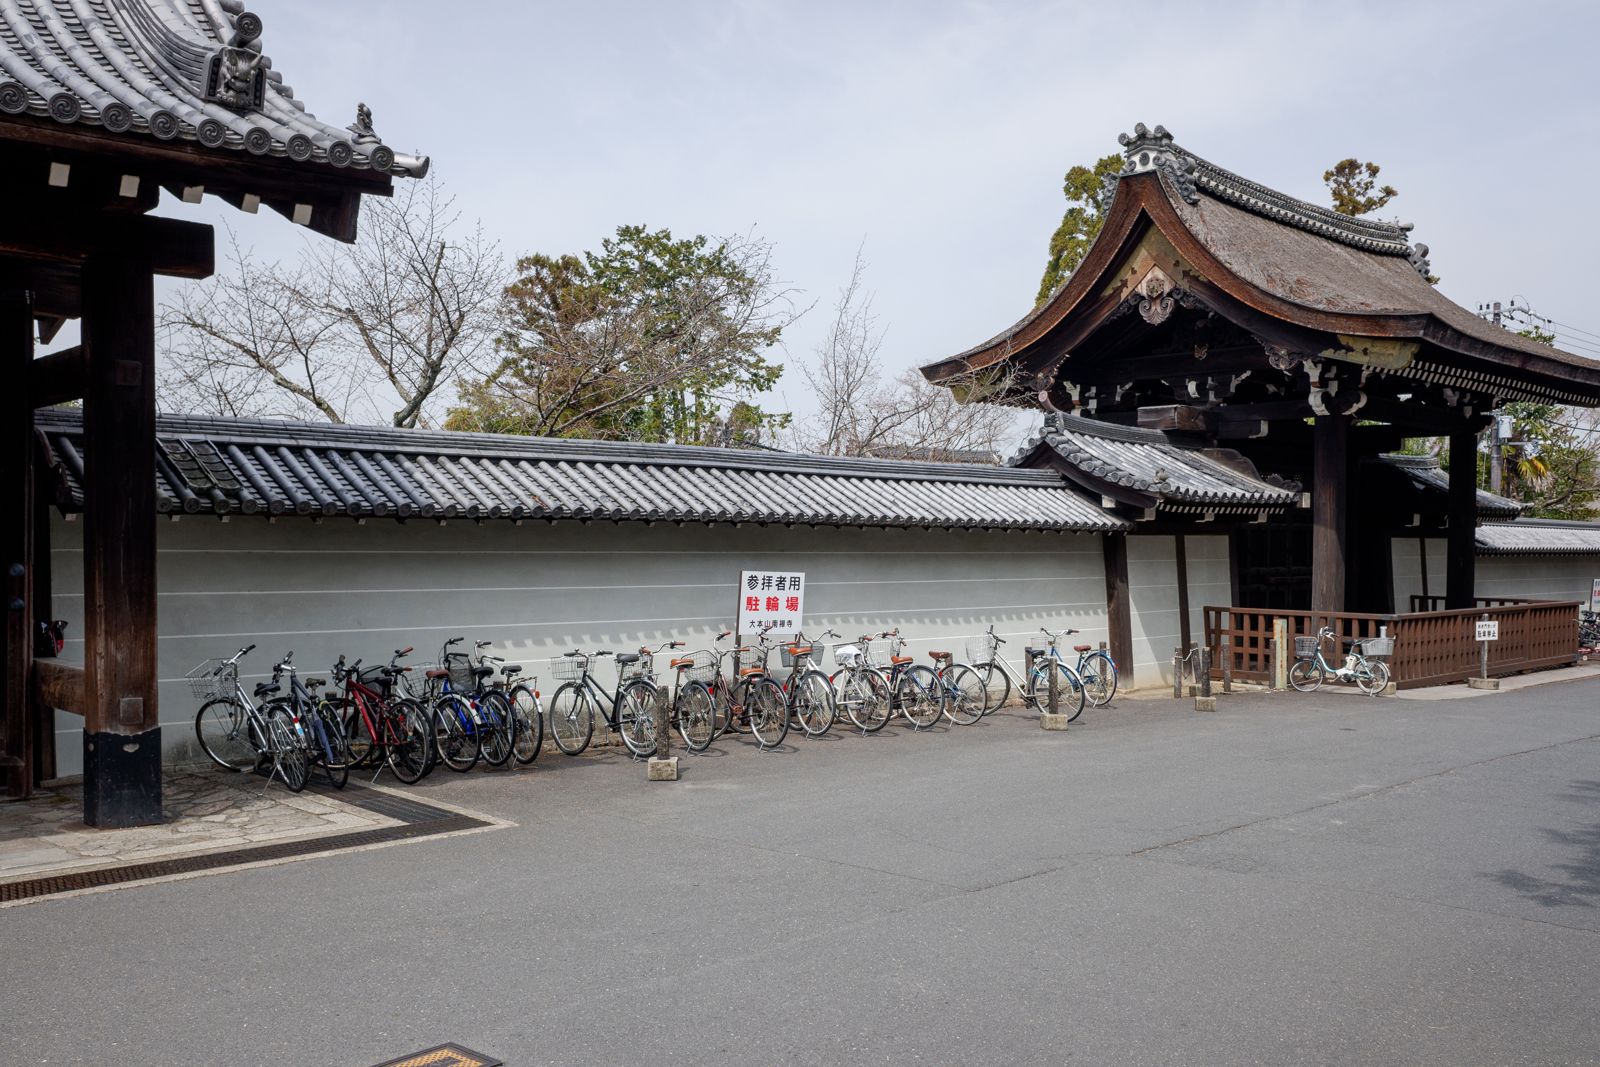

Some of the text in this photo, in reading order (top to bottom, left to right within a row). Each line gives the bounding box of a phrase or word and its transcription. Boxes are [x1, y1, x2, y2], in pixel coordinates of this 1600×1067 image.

[747, 574, 801, 591] 参拝者用
[745, 596, 799, 612] 駐輪場
